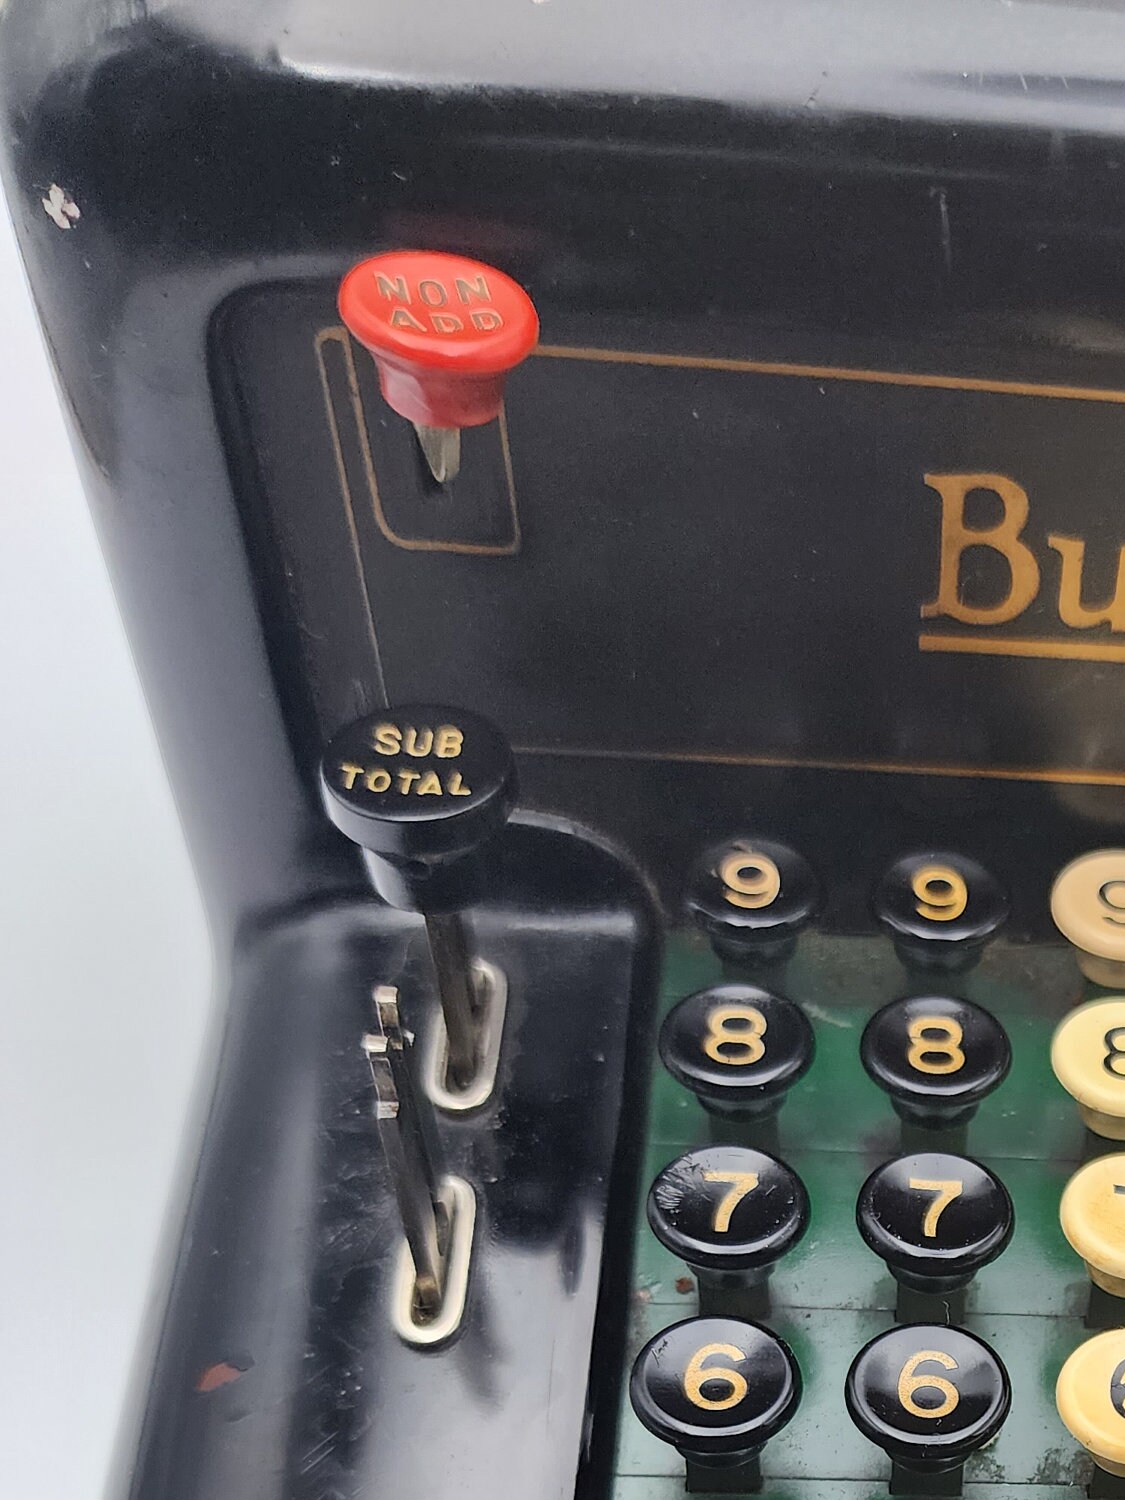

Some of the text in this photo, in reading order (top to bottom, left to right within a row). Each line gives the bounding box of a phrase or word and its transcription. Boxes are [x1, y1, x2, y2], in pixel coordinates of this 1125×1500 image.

[373, 271, 491, 306] NON
[390, 305, 505, 334] ADD
[372, 725, 465, 759] SUB
[340, 763, 472, 797] TOTAL
[721, 853, 780, 908] 9
[912, 866, 967, 920] 9
[704, 1004, 766, 1064] 8
[908, 1015, 964, 1074] 8
[700, 1172, 758, 1232] 7
[910, 1177, 962, 1237] 7
[684, 1343, 747, 1410] 6
[898, 1350, 959, 1418] 6
